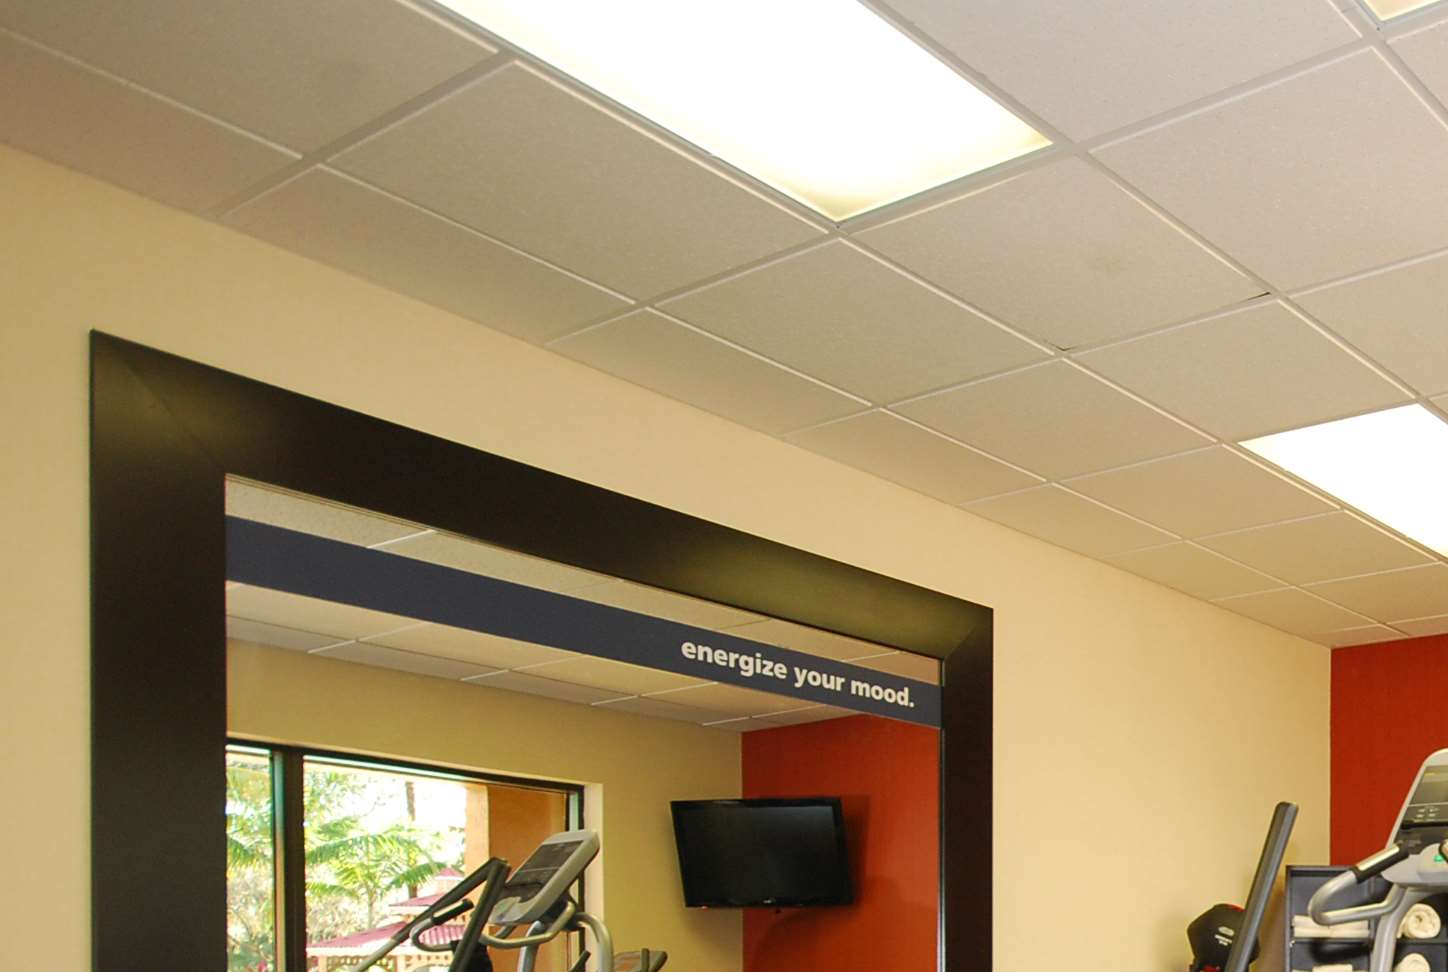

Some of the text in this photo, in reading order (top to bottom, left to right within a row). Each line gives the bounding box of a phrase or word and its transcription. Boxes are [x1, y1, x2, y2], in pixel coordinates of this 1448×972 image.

[681, 641, 916, 708] energize your mood.
